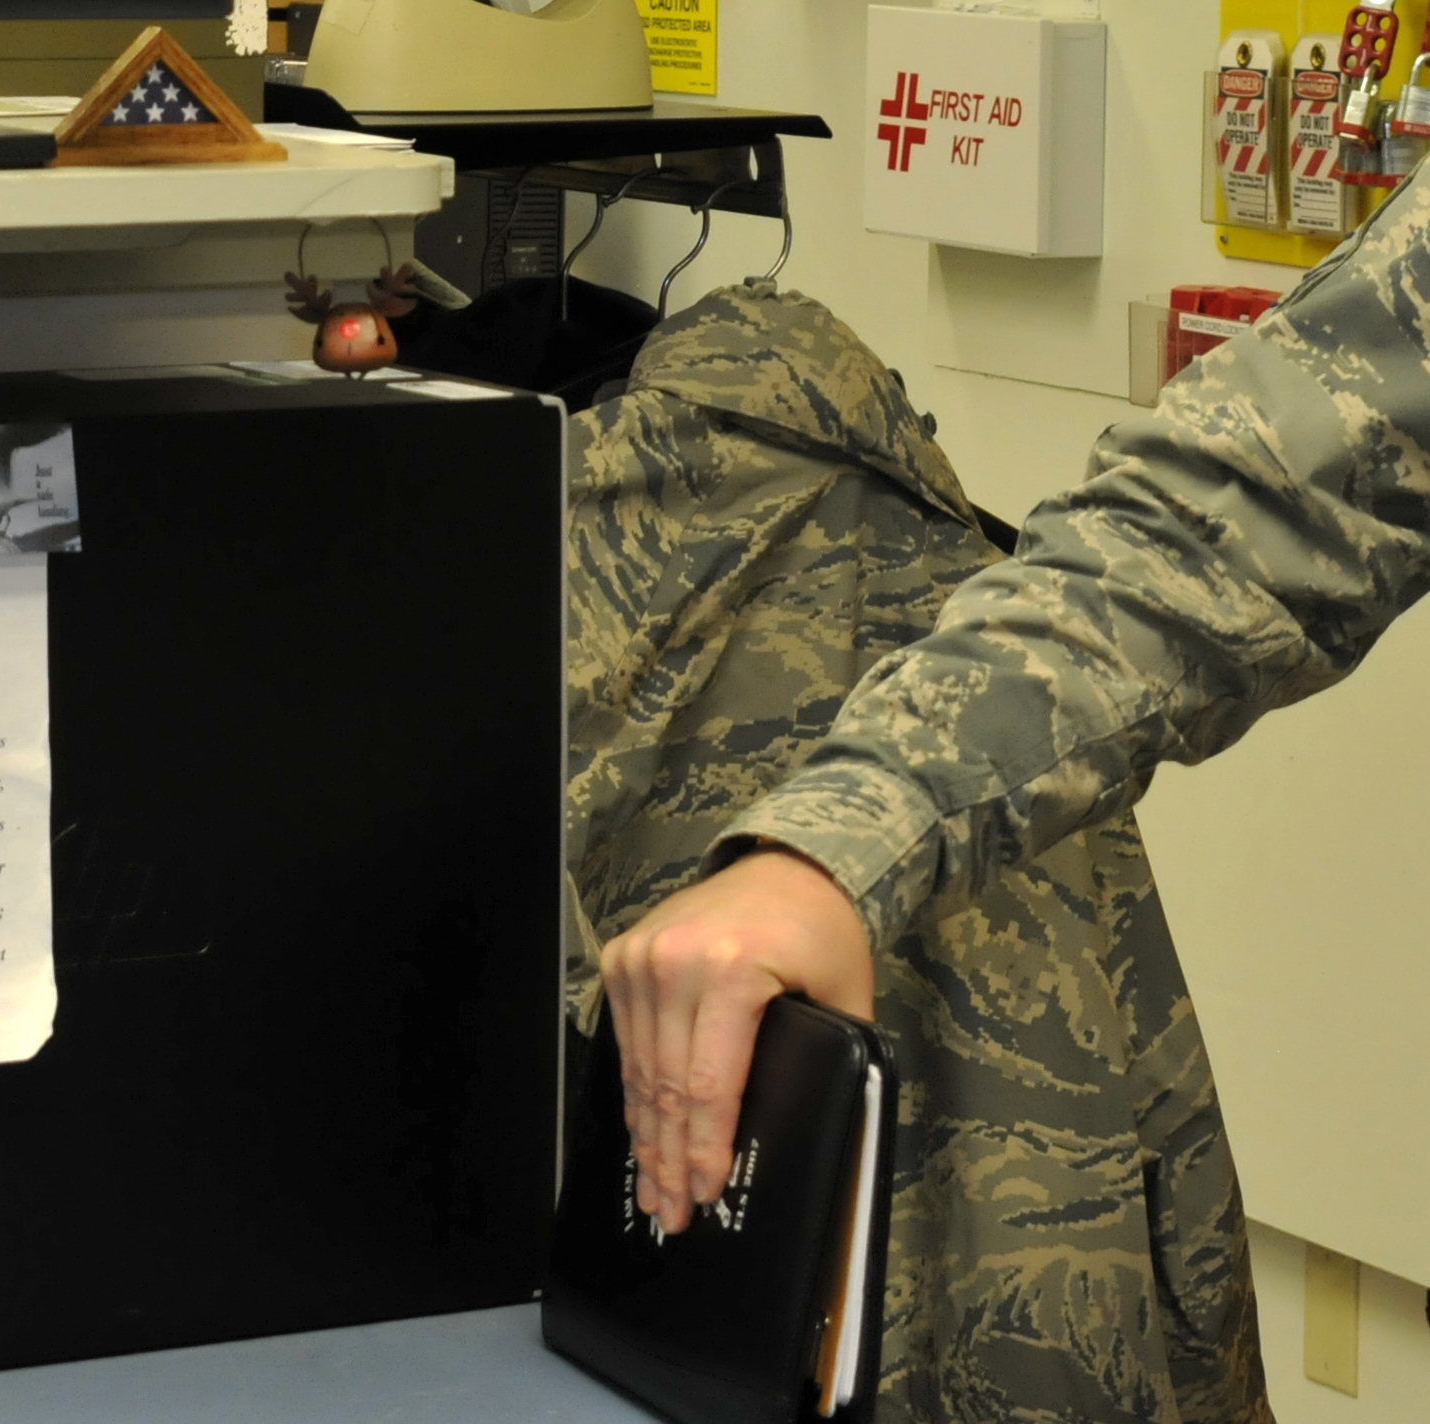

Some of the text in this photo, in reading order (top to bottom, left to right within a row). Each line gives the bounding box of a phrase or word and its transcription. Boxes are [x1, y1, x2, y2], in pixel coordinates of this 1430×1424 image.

[652, 17, 691, 31] PROTECTED
[693, 20, 711, 32] AREA
[928, 89, 1023, 127] FIRST AID
[1226, 111, 1255, 127] DO NOT
[1300, 115, 1329, 131] DO NOT
[1225, 129, 1259, 145] OPERATE
[1298, 132, 1333, 149] OPERATE
[950, 135, 985, 166] KIT
